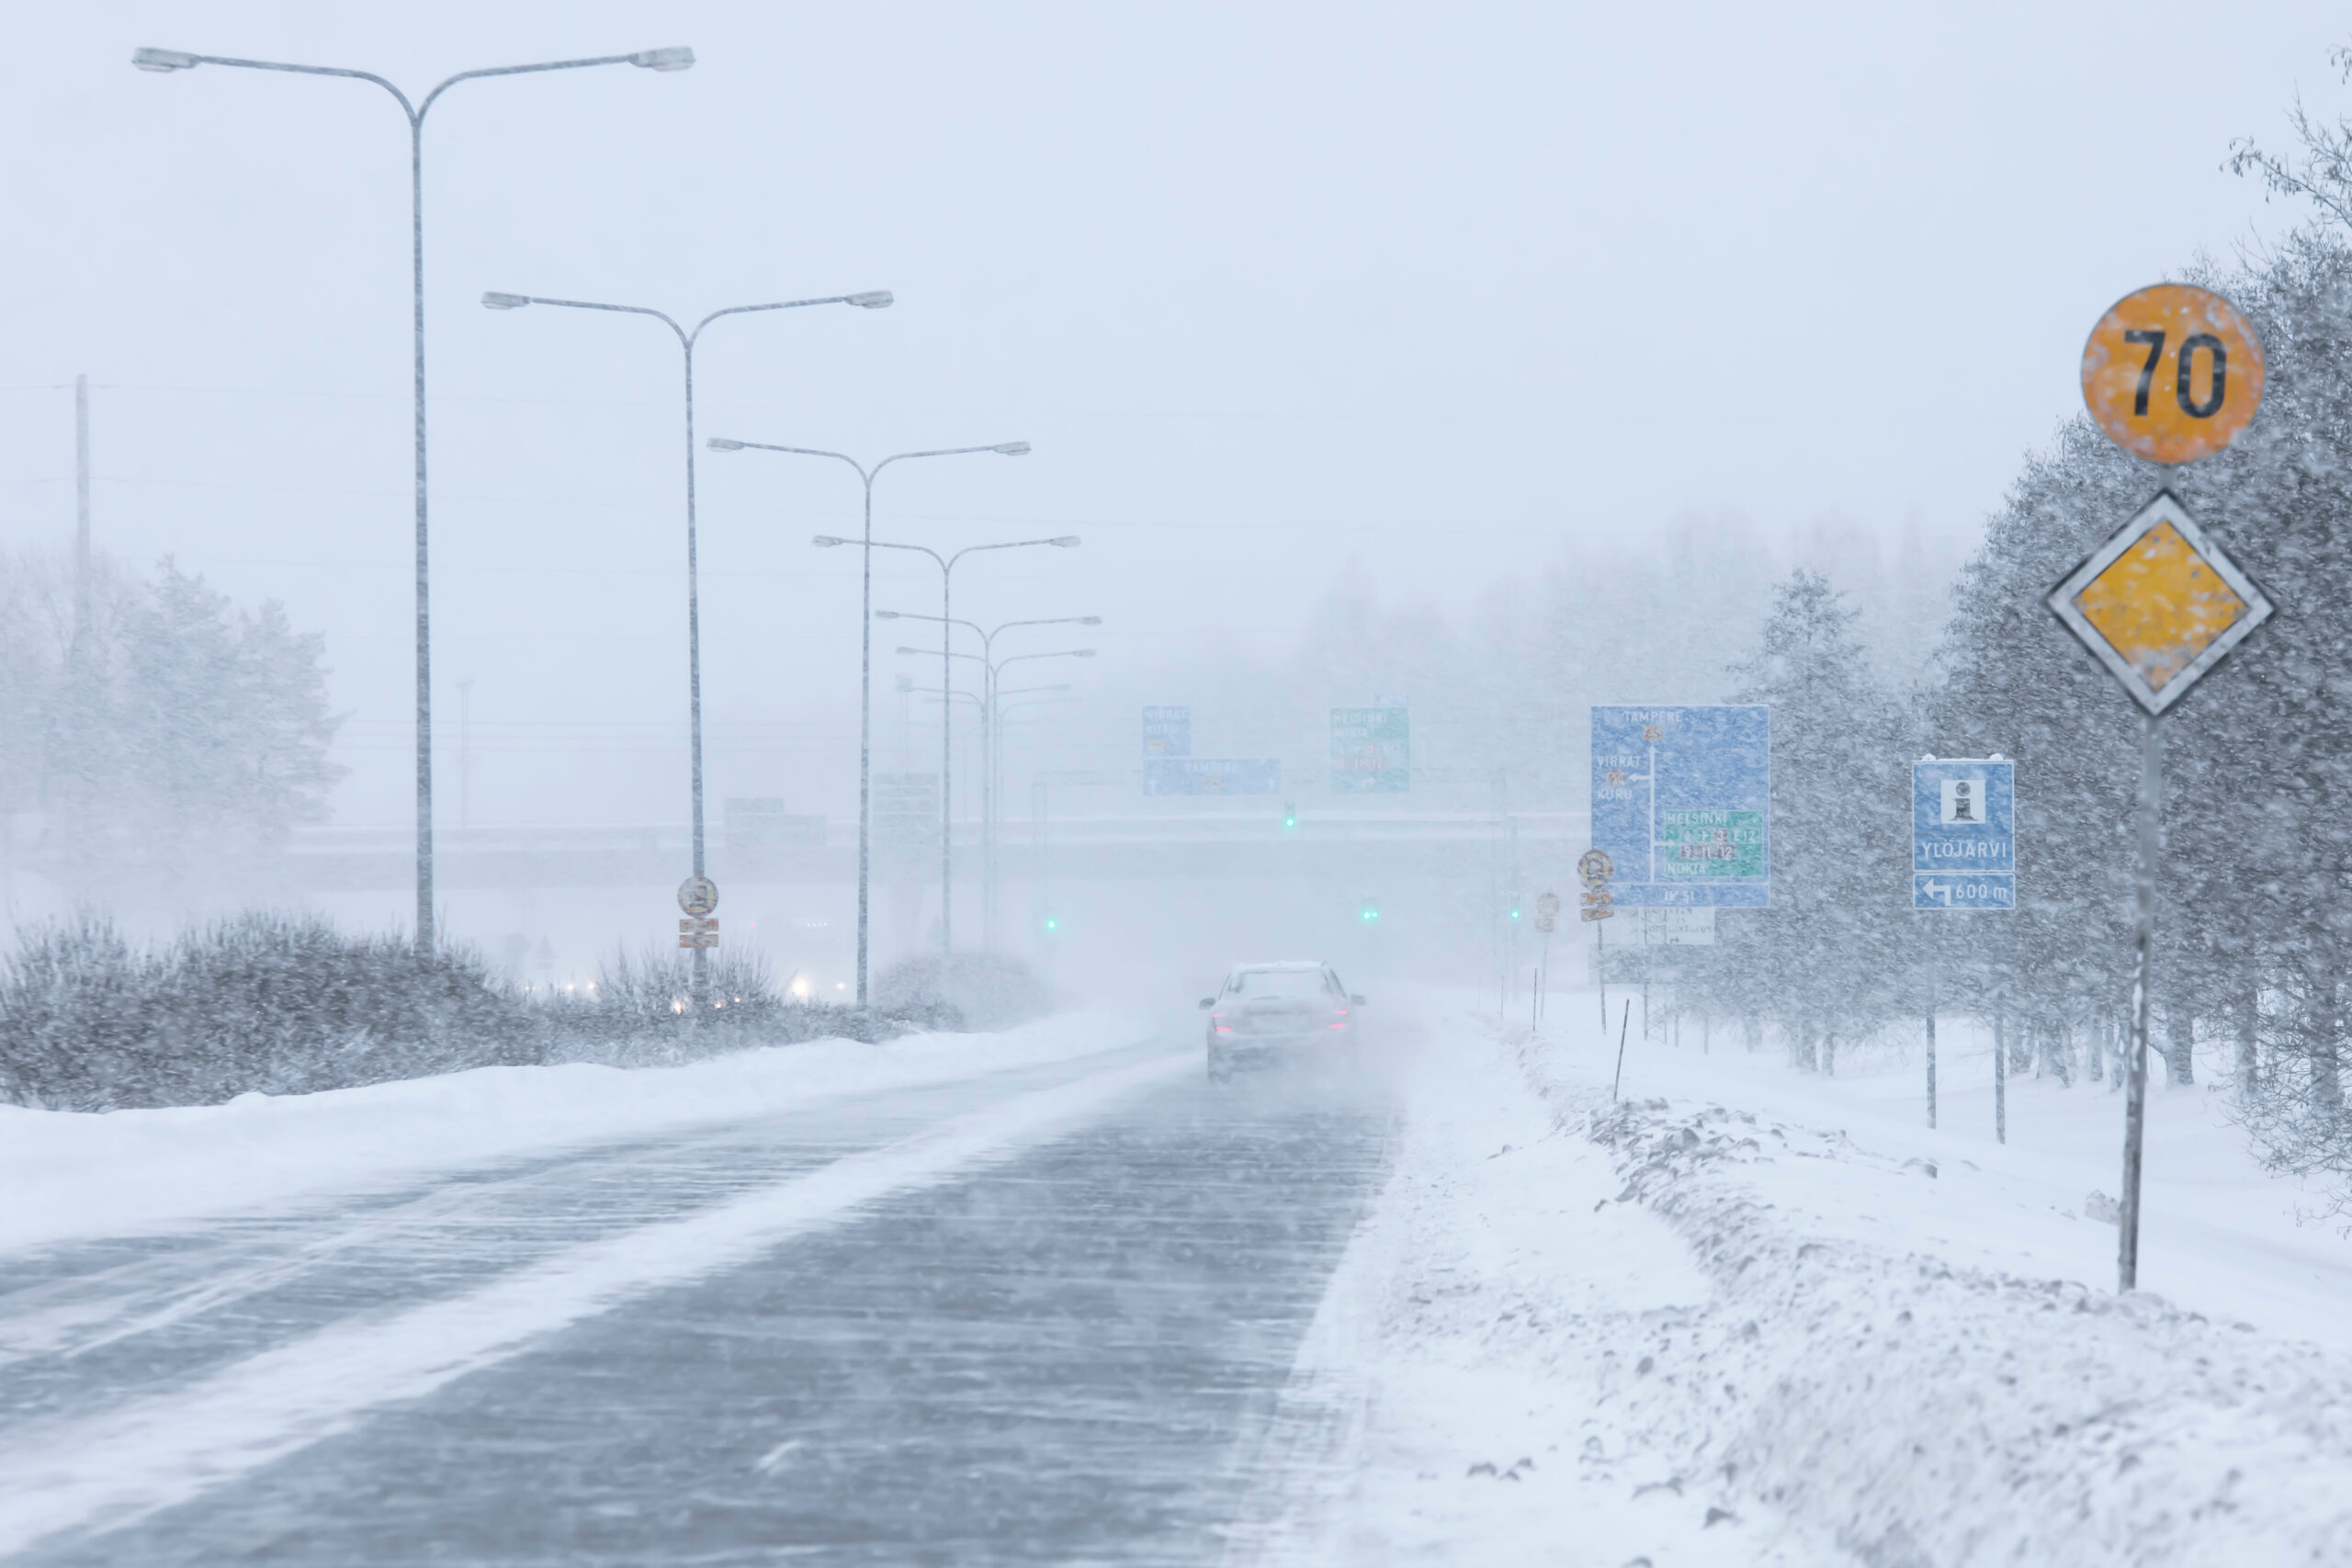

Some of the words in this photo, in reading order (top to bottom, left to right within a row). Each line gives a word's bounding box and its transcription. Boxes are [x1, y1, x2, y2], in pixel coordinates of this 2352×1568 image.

[2124, 330, 2227, 419] 70
[1597, 756, 1641, 767] VIRRAT
[1597, 790, 1633, 801] KURU
[1668, 812, 1726, 825] HELSINKI
[1734, 829, 1756, 842] E12
[1685, 846, 1690, 858] 9
[1721, 846, 1733, 859] 12
[1922, 839, 2007, 859] YLÖJÄRVI
[1668, 863, 1706, 874] NOKIA
[1956, 884, 1988, 899] 600
[1994, 886, 2007, 899] m
